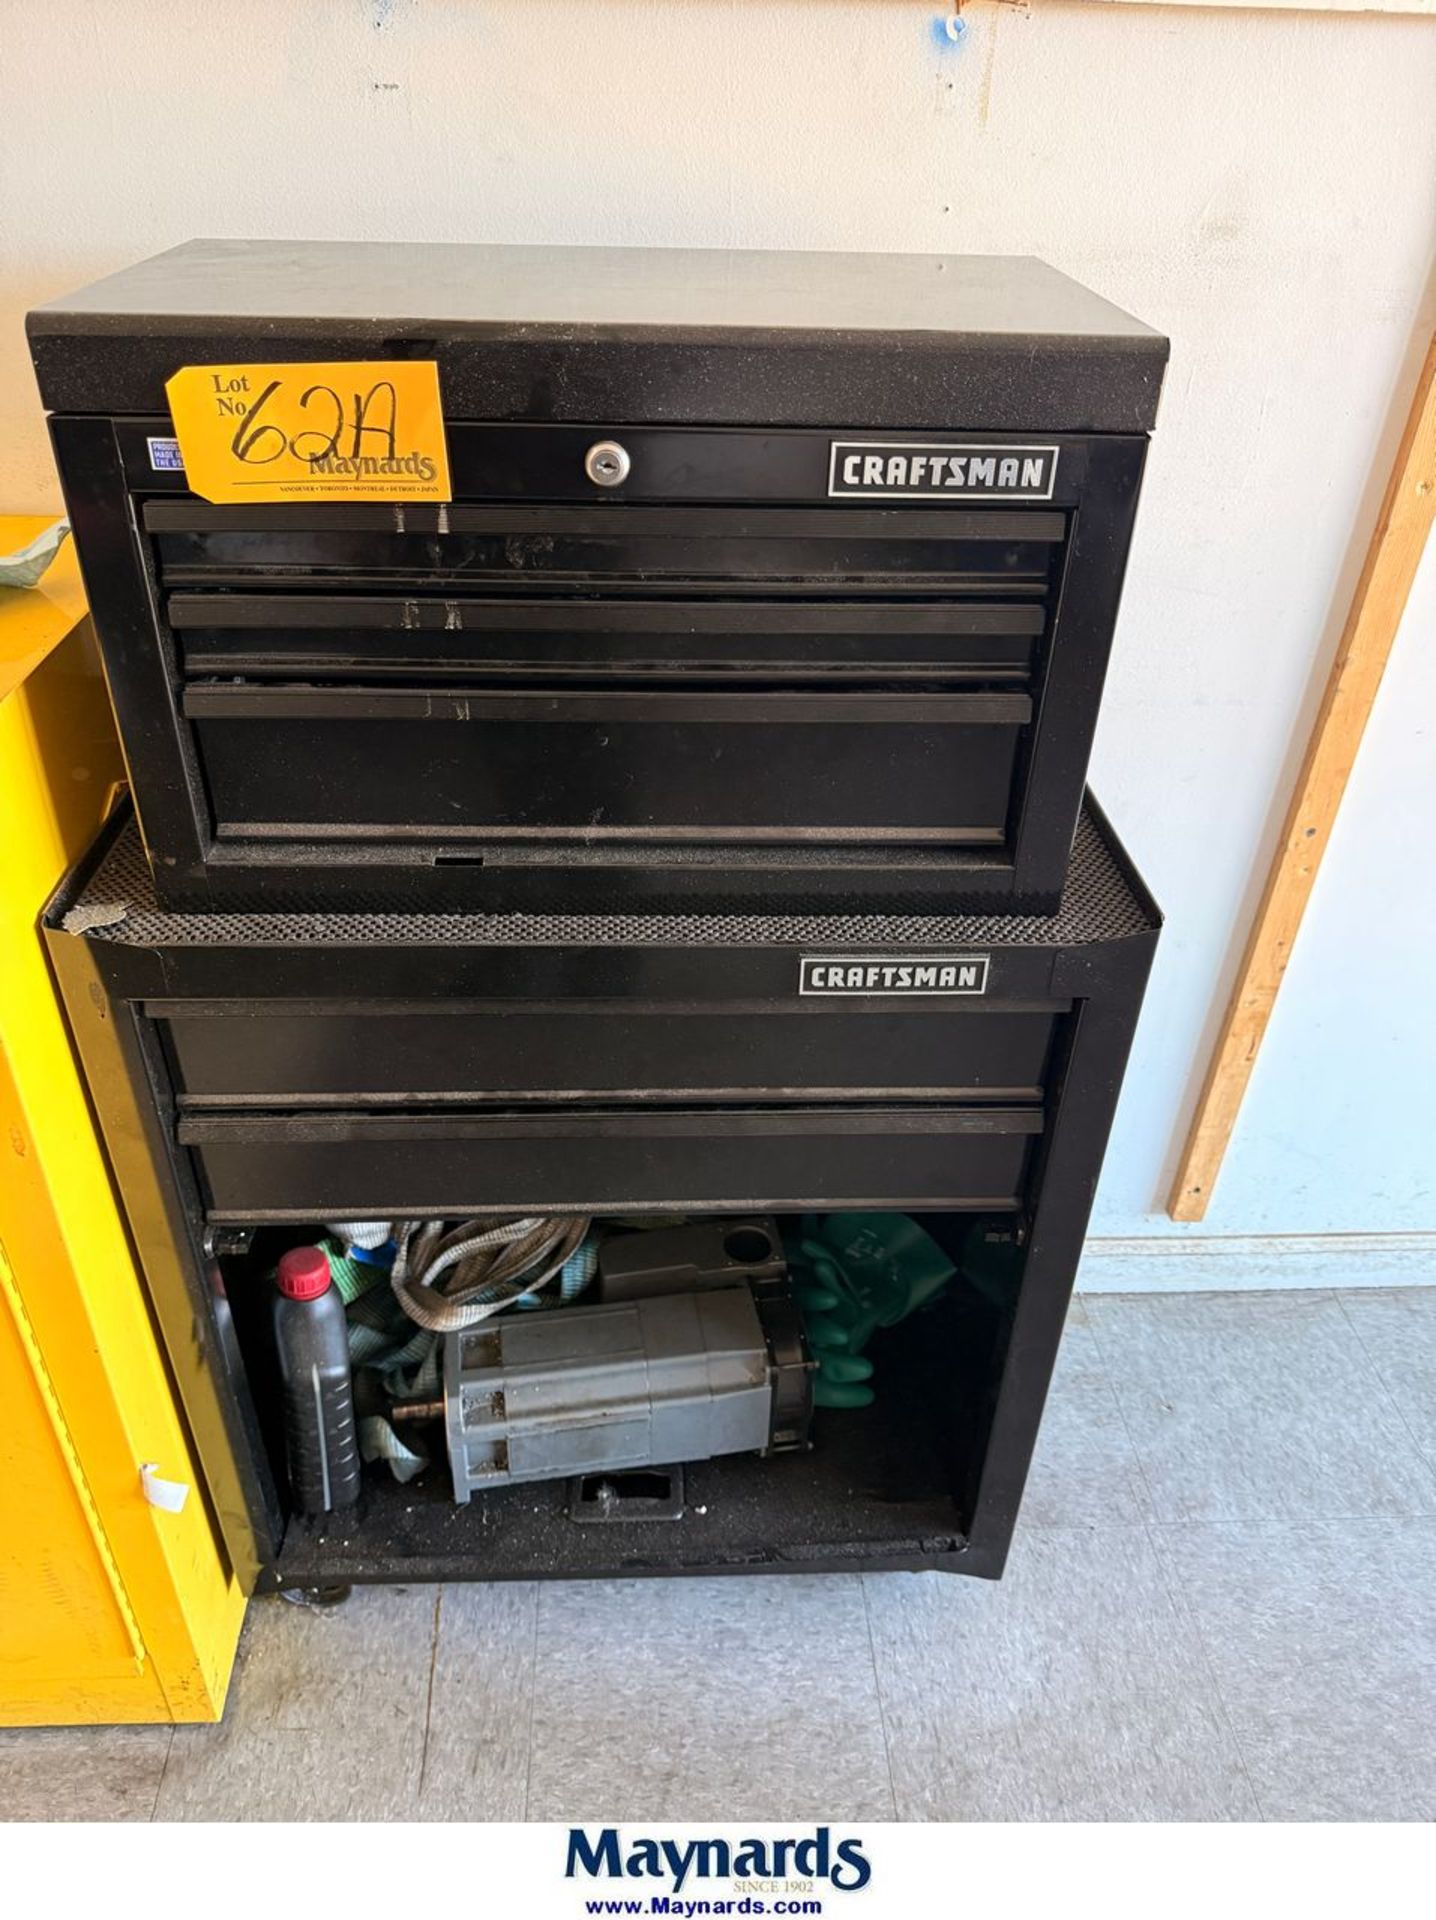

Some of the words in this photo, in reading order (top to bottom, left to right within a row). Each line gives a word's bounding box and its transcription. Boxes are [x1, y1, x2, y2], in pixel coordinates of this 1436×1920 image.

[211, 374, 250, 393] Lot
[231, 381, 396, 464] 62A
[309, 451, 438, 481] Maynards
[842, 455, 1044, 487] CRAFTSMAN
[811, 966, 977, 987] CRAFTSMAN
